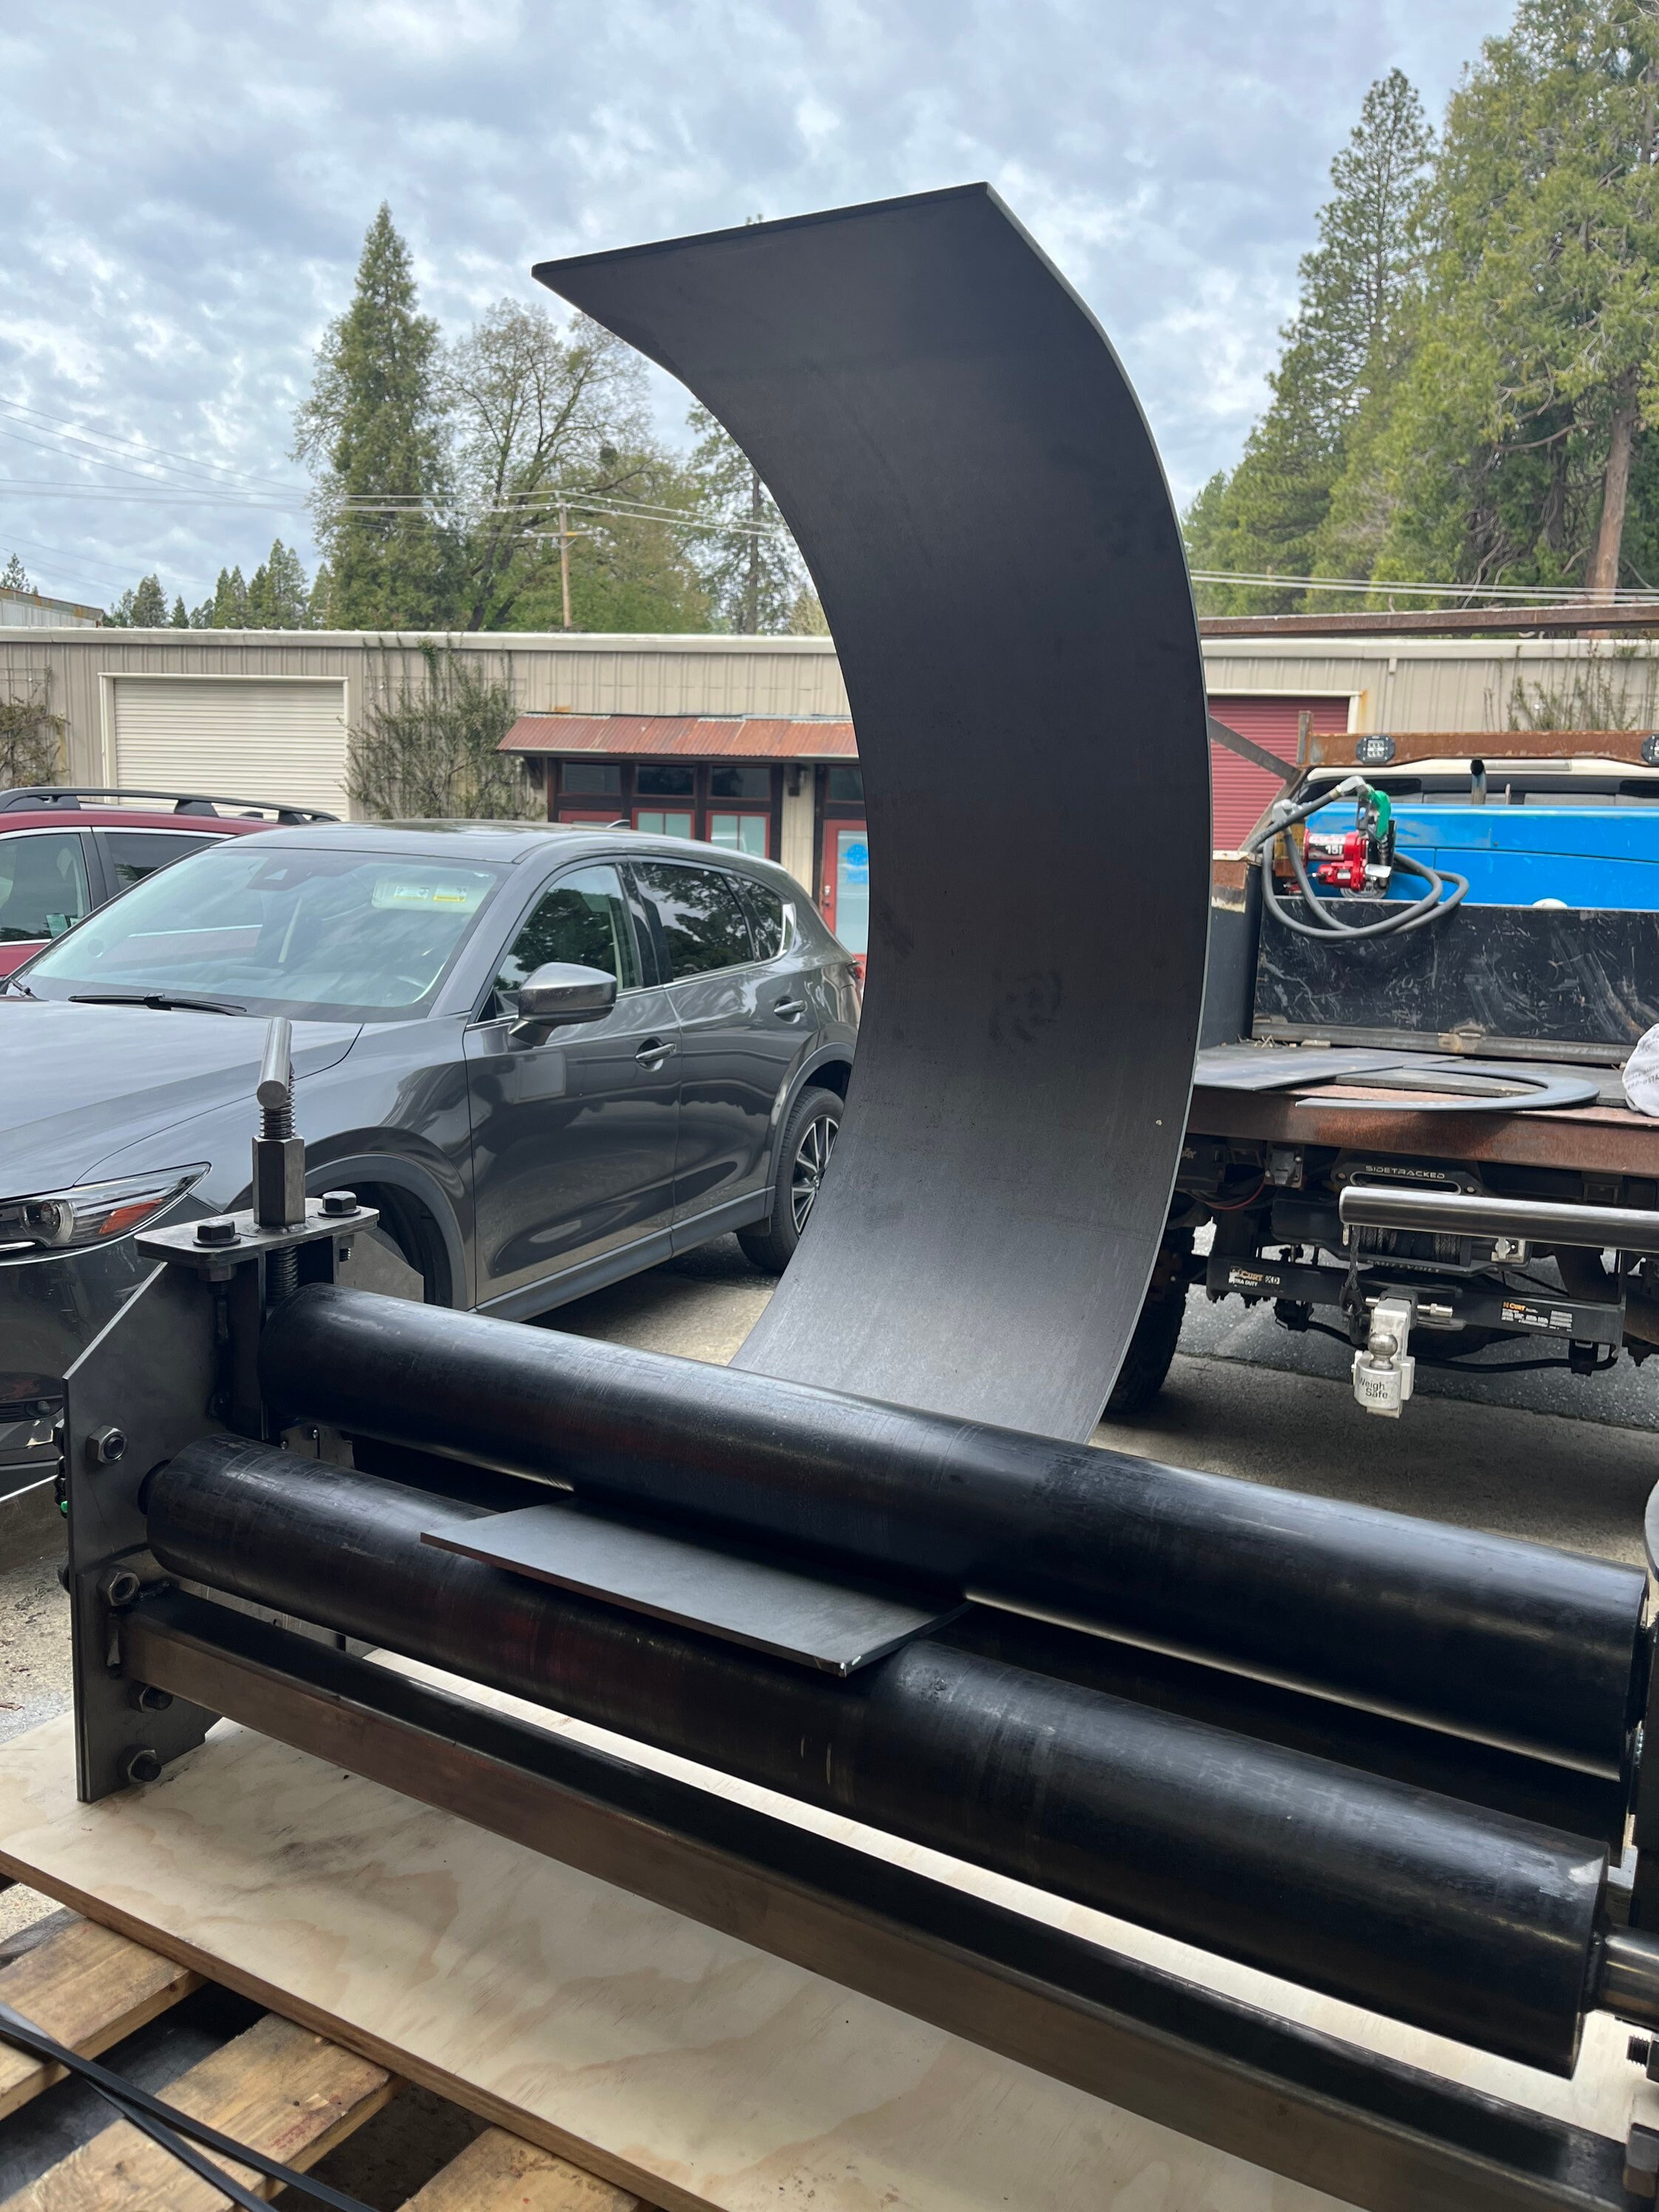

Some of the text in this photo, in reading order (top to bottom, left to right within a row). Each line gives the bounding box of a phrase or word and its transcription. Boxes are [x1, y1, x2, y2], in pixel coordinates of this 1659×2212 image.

[1365, 1165, 1445, 1179] SIDETRACKED
[1509, 1303, 1526, 1311] CURT
[1365, 1388, 1388, 1399] Safe
